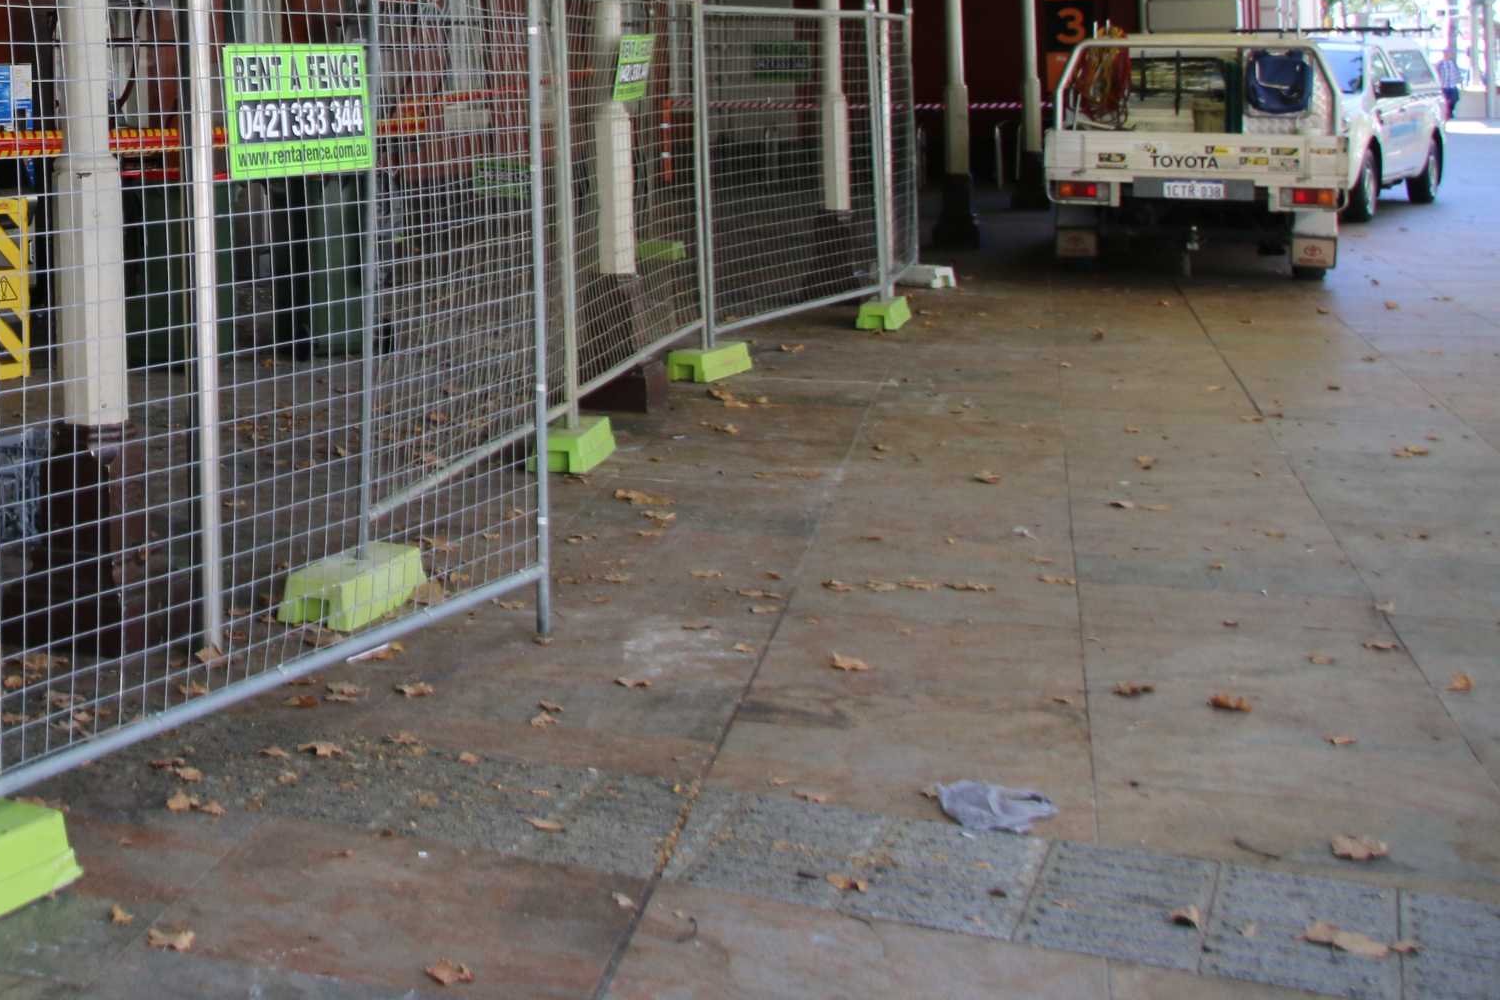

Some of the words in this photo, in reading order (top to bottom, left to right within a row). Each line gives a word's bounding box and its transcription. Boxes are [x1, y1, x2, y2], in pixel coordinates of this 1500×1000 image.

[1057, 6, 1086, 45] 3
[232, 55, 283, 93] RENT
[289, 55, 303, 91] A
[306, 53, 361, 90] FENCE
[330, 99, 364, 134] 344
[237, 142, 368, 168] www.rentafence.com.au
[1150, 155, 1219, 169] TOYOTA
